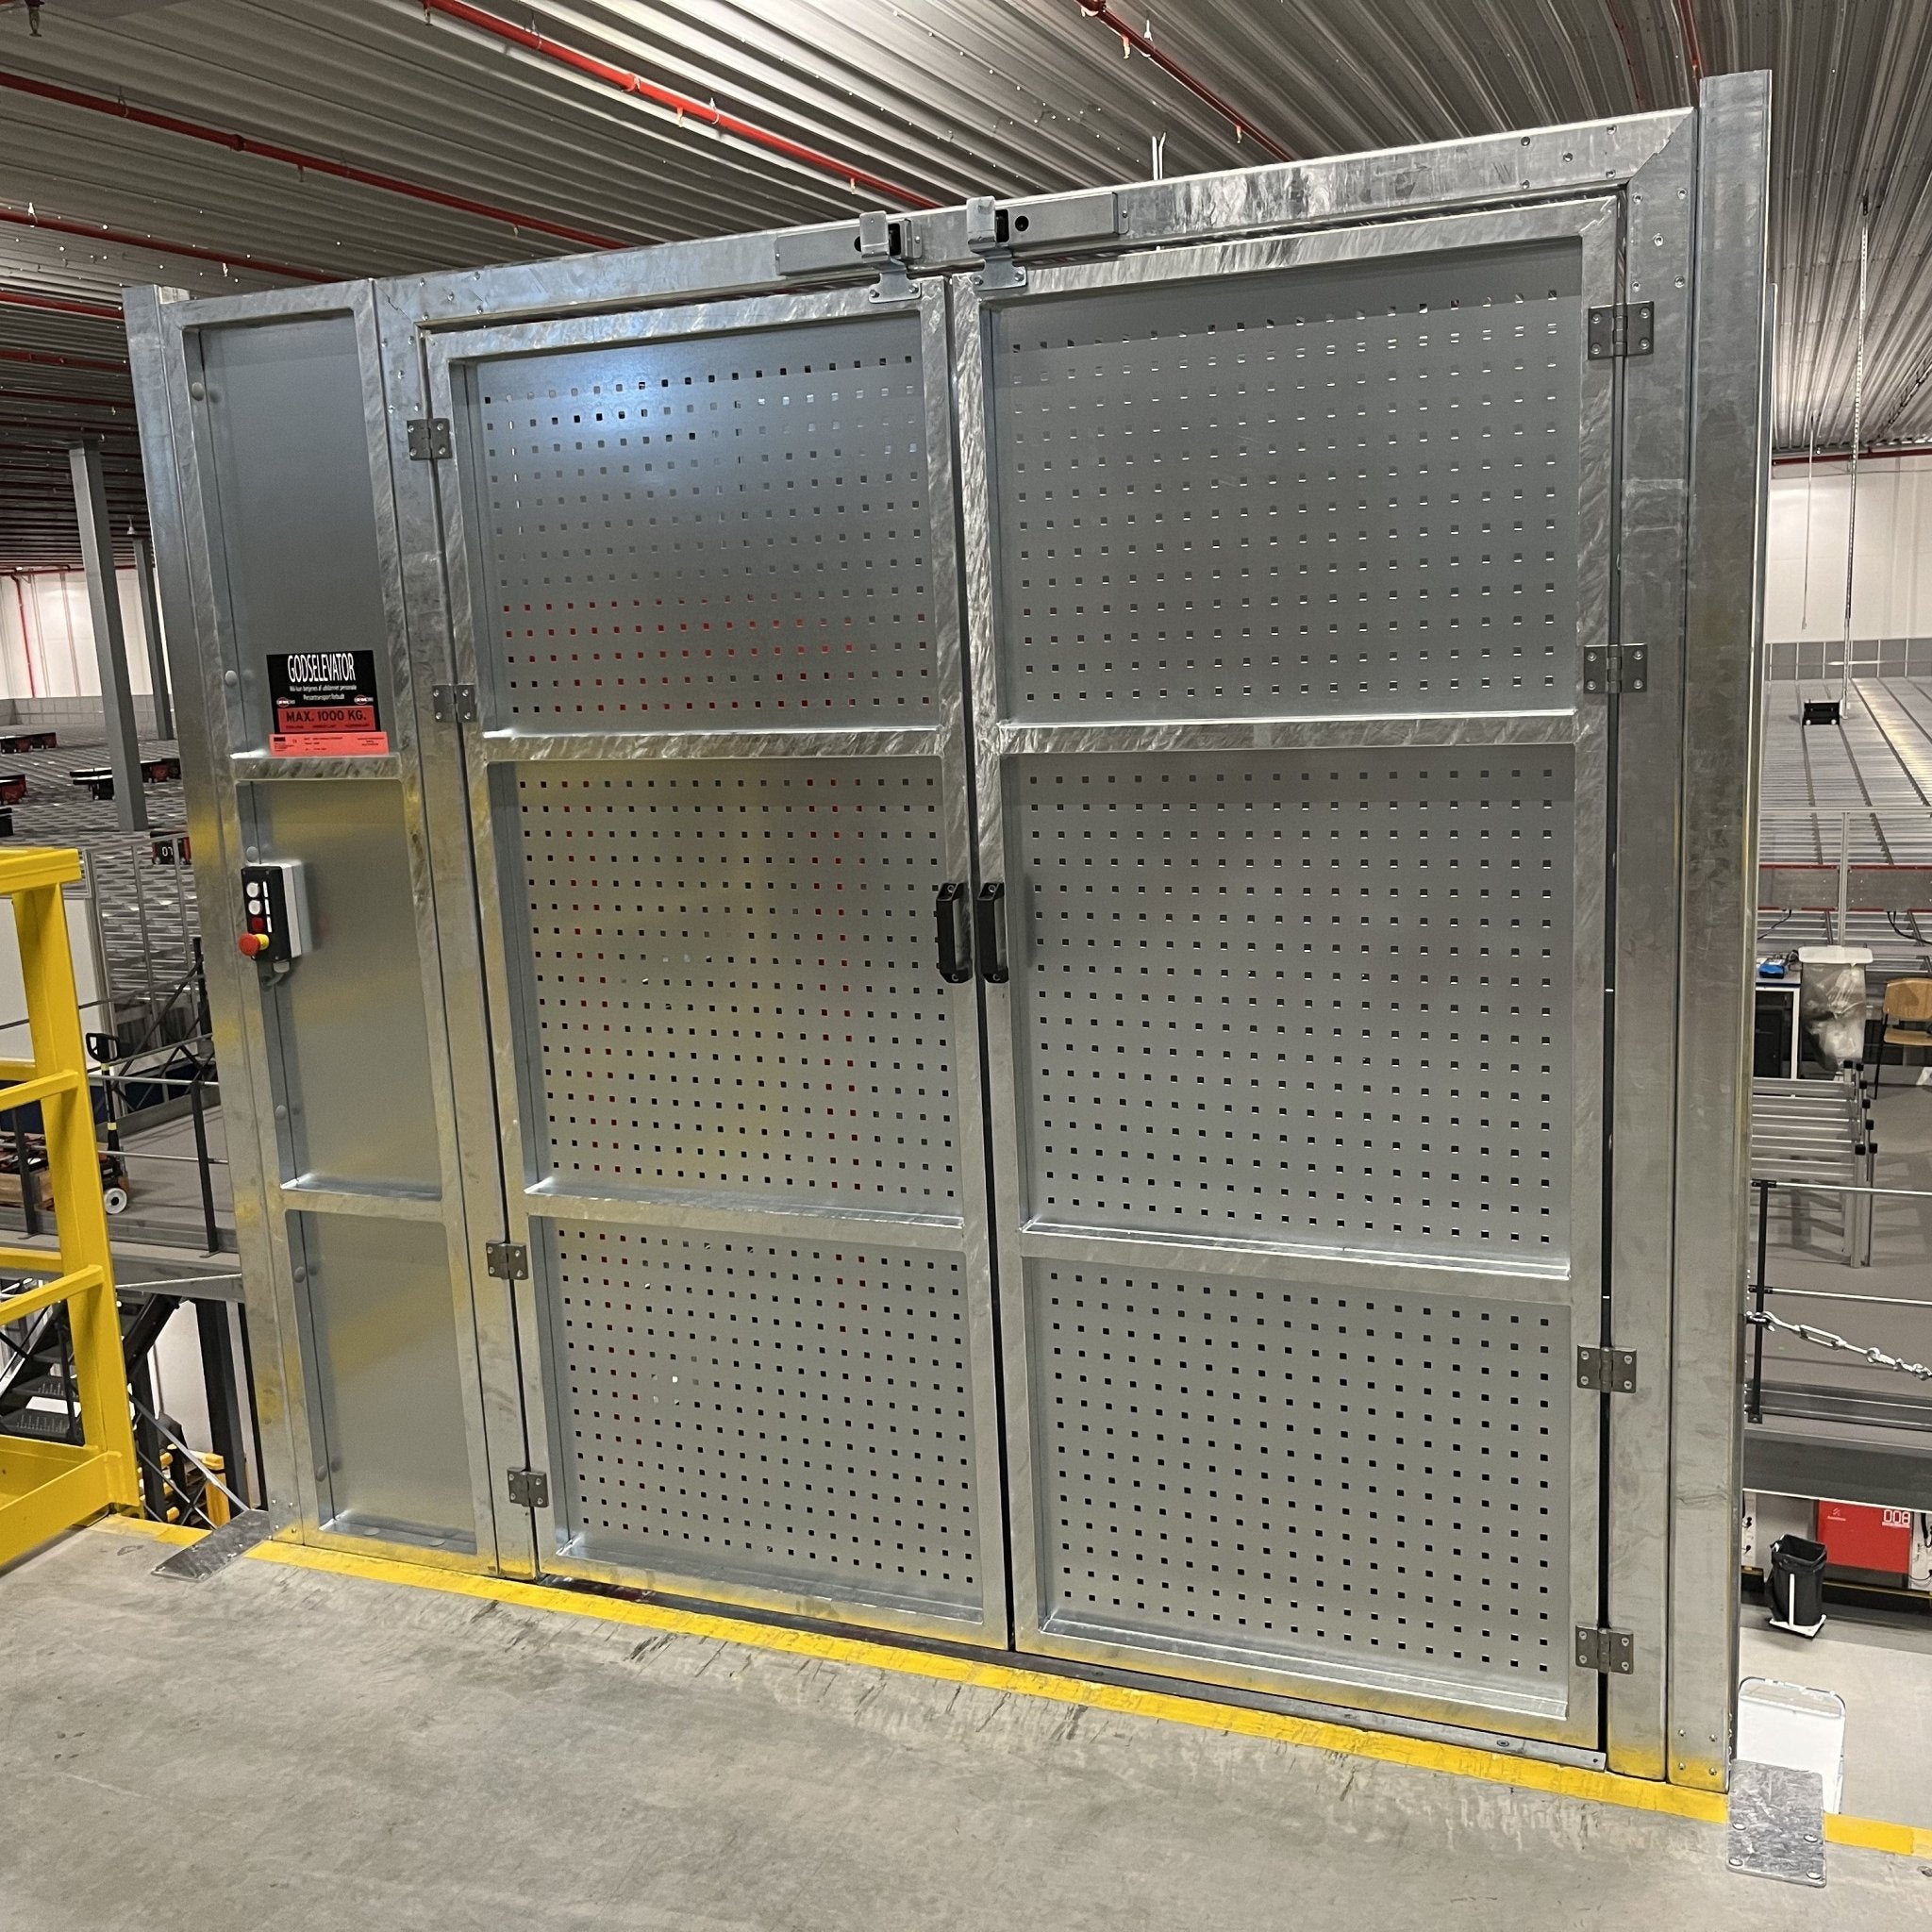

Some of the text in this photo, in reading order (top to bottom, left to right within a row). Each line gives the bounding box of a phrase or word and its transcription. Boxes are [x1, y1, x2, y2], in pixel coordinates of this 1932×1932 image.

[288, 653, 356, 682] GODSELEVATOR
[286, 709, 367, 722] MAX. 1000 KG.
[1884, 1509, 1911, 1524] 008
